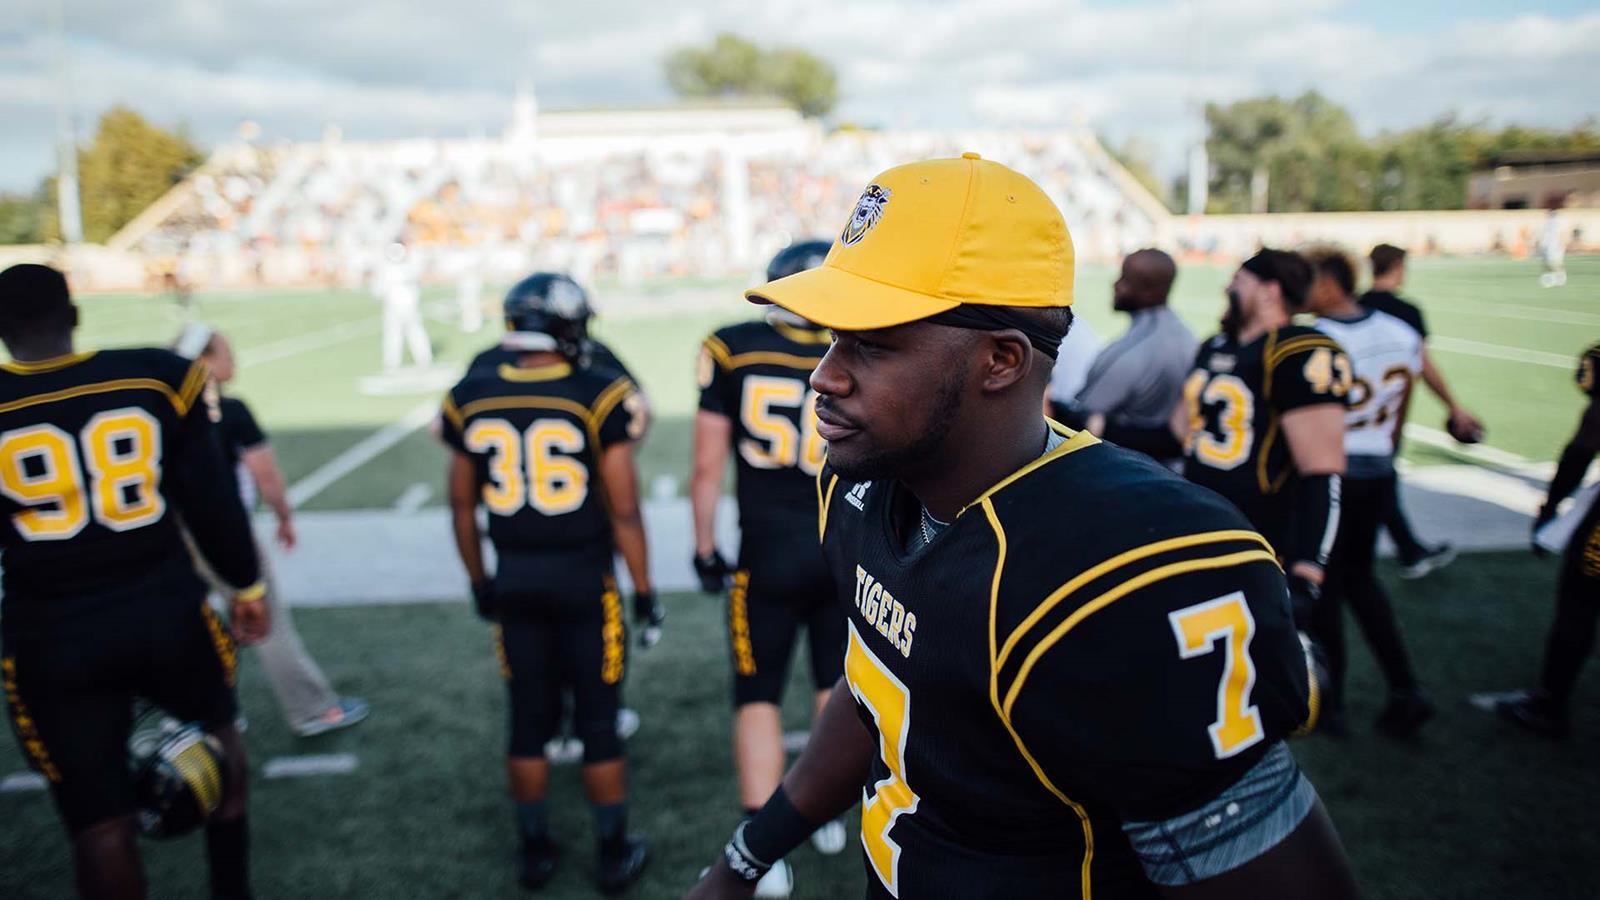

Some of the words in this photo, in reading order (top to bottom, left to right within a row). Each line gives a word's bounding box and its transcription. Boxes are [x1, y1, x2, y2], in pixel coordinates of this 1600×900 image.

[1303, 346, 1352, 397] 43
[0, 407, 165, 541] 98
[464, 417, 589, 516] 36
[855, 563, 917, 659] TIGERS
[1168, 590, 1265, 760] 7
[844, 616, 921, 899] 7
